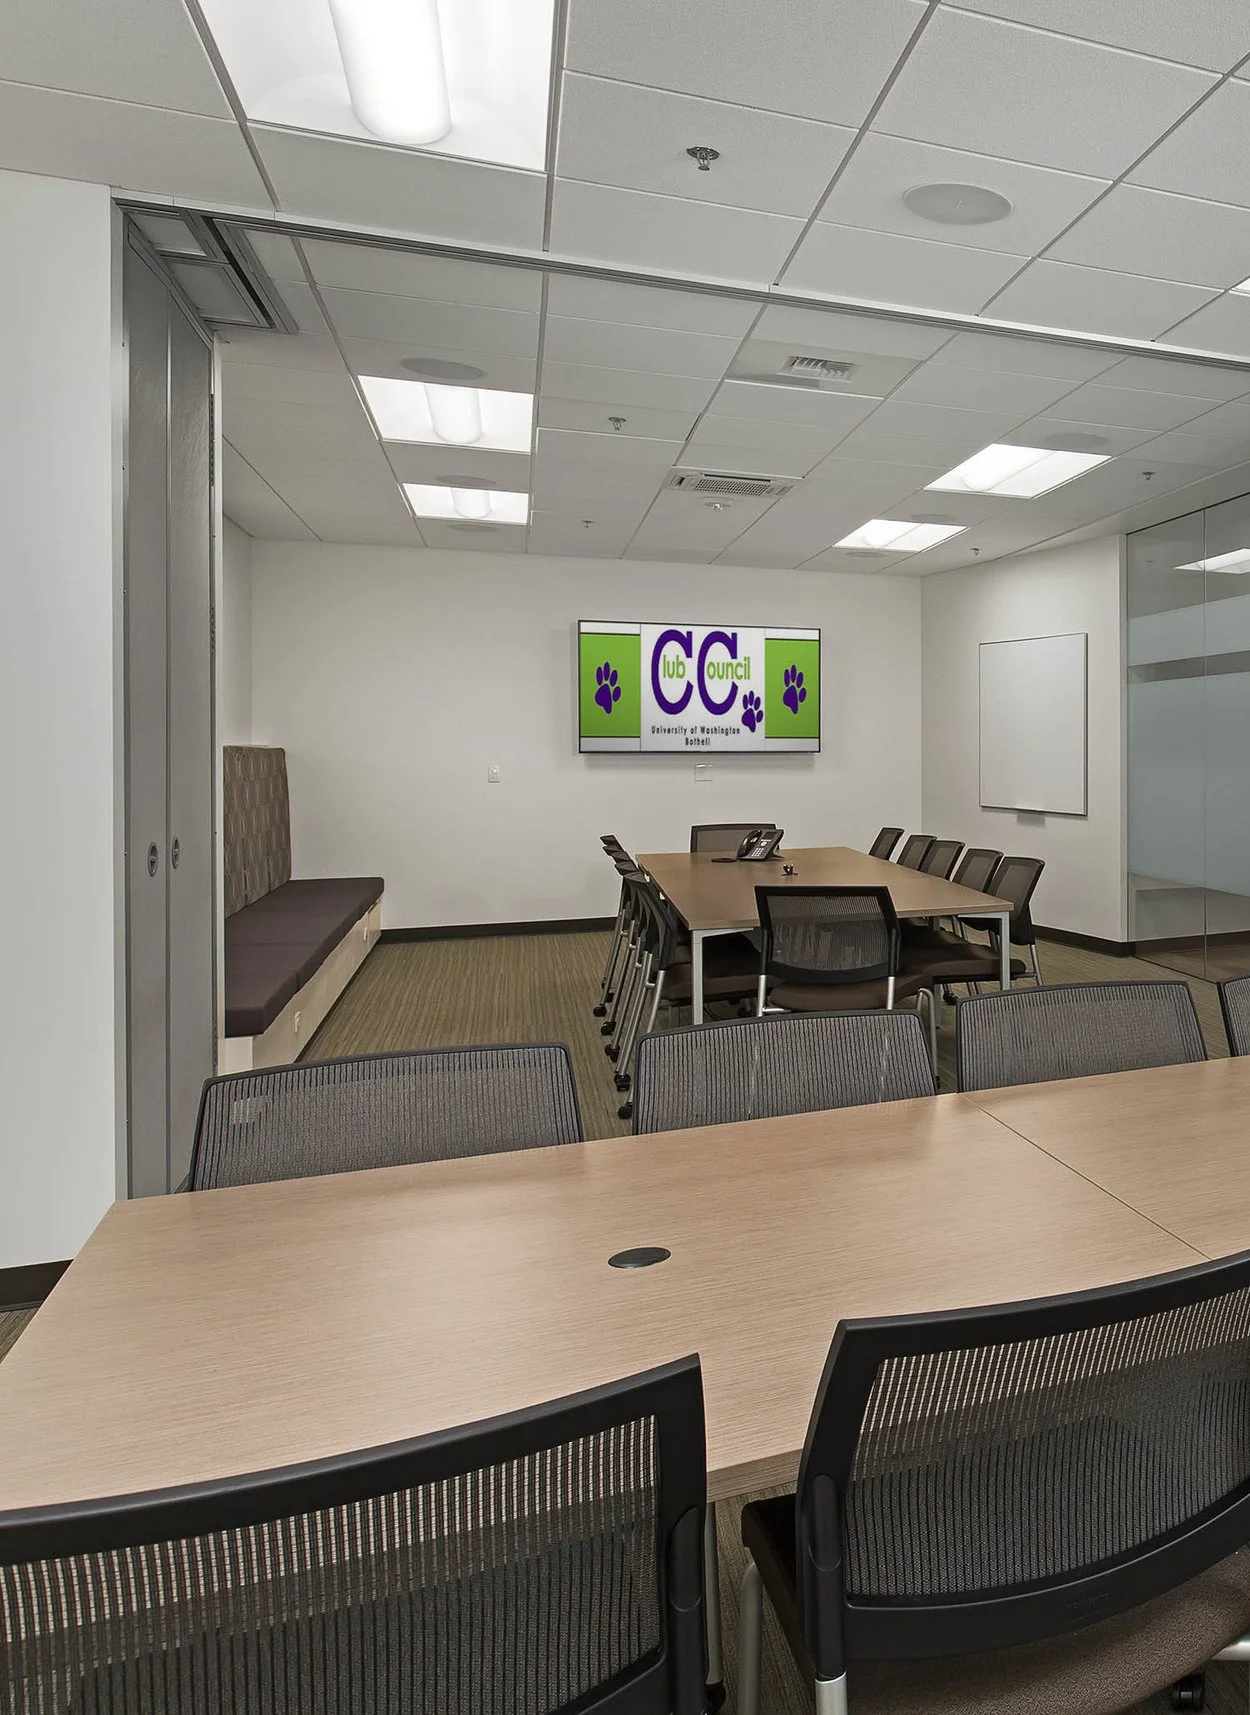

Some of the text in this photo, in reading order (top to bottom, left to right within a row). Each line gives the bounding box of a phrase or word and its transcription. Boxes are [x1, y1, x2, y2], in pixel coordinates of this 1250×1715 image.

[651, 726, 740, 736] University of Washington
[685, 737, 710, 746] Bothell
